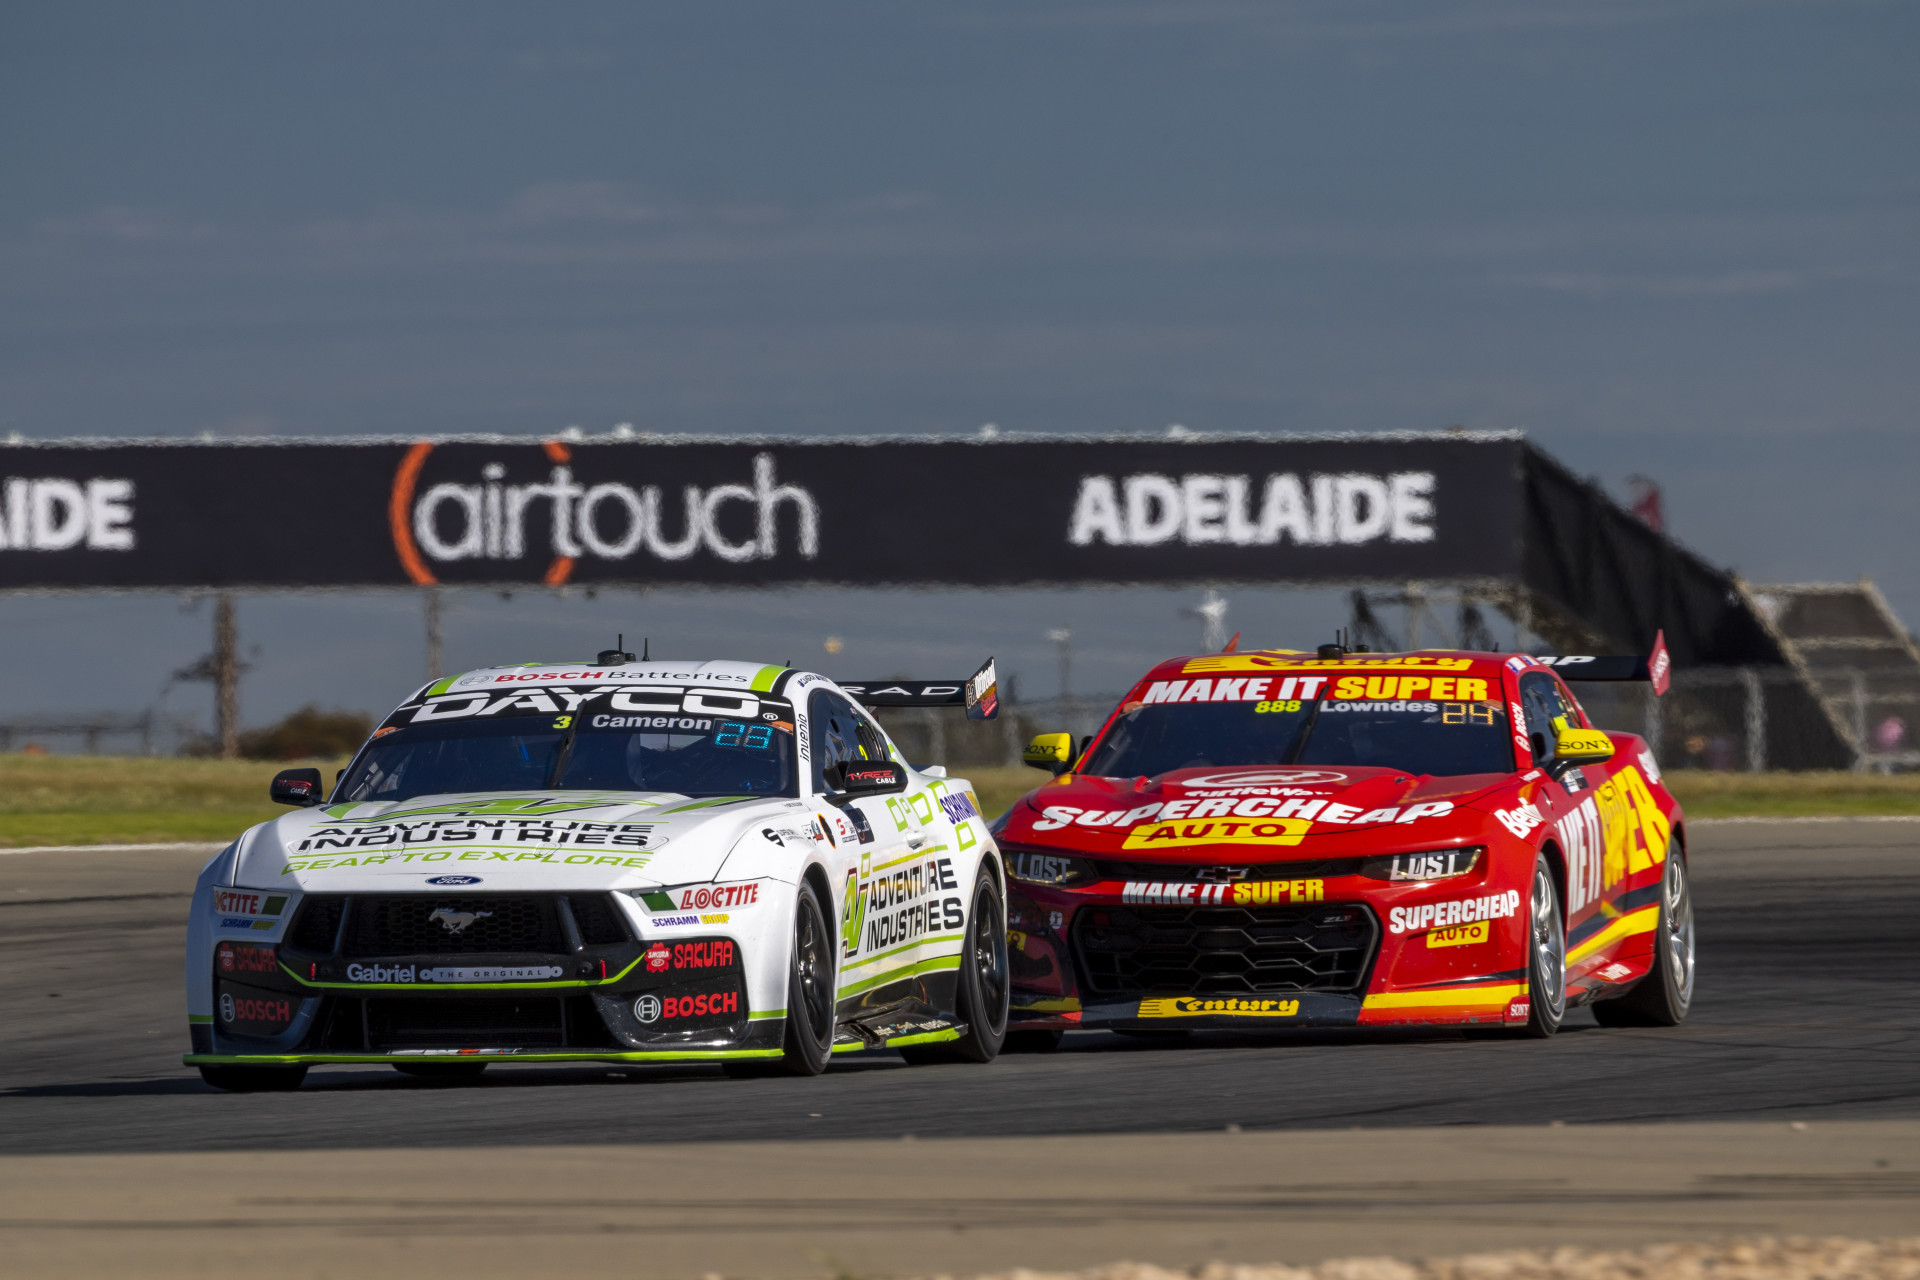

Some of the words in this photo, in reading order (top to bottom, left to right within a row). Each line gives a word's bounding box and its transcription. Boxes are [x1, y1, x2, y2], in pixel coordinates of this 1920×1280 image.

[0, 477, 136, 550] IDE
[414, 452, 820, 561] airtouch
[1069, 472, 1439, 546] ADELAIDE
[494, 671, 604, 683] BOSCH
[607, 671, 748, 683] Batteries
[1142, 678, 1272, 704] MAKE
[1278, 677, 1328, 700] IT
[1334, 676, 1488, 701] SUPER
[409, 686, 760, 723] DAYCO
[1254, 700, 1302, 713] 888
[1319, 701, 1439, 713] Lowndes
[1442, 702, 1494, 726] 24
[552, 715, 573, 729] 3
[592, 714, 712, 730] Cameron
[1510, 701, 1528, 737] BOSCH
[714, 721, 774, 750] 23
[797, 713, 810, 763] invenio
[1558, 740, 1612, 750] SONY
[1022, 744, 1062, 754] SONY
[846, 769, 895, 780] TYREE
[1032, 797, 1455, 831] SUPERCHEAP
[297, 828, 648, 851] INDUSTRIES
[309, 819, 655, 838] ADVENTURE
[1142, 822, 1287, 843] AUTO
[280, 856, 388, 876] GEAR
[402, 851, 453, 863] TO
[457, 851, 652, 869] EXPLORE
[1017, 853, 1071, 884] LOST
[1389, 850, 1460, 881] LOST
[680, 882, 759, 910] LOCTITE
[869, 857, 959, 914] ADVENTURE
[1122, 881, 1196, 904] MAKE
[1199, 883, 1231, 904] IT
[1233, 879, 1324, 904] SUPER
[652, 915, 700, 928] SCHRAMM
[701, 913, 730, 925] GROUP
[1389, 889, 1520, 934] SUPERCHEAP
[866, 896, 965, 953] INDUSTRIES
[1433, 925, 1482, 943] AUTO
[236, 947, 279, 973] SAKURA
[674, 941, 734, 969] SAKURA
[346, 963, 416, 983] Gabriel
[438, 971, 465, 979] THE
[474, 970, 543, 978] ORIGINAL
[235, 998, 290, 1022] BOSCH
[663, 992, 738, 1019] BOSCH
[1175, 997, 1300, 1015] Century
[1510, 1002, 1530, 1016] SONY
